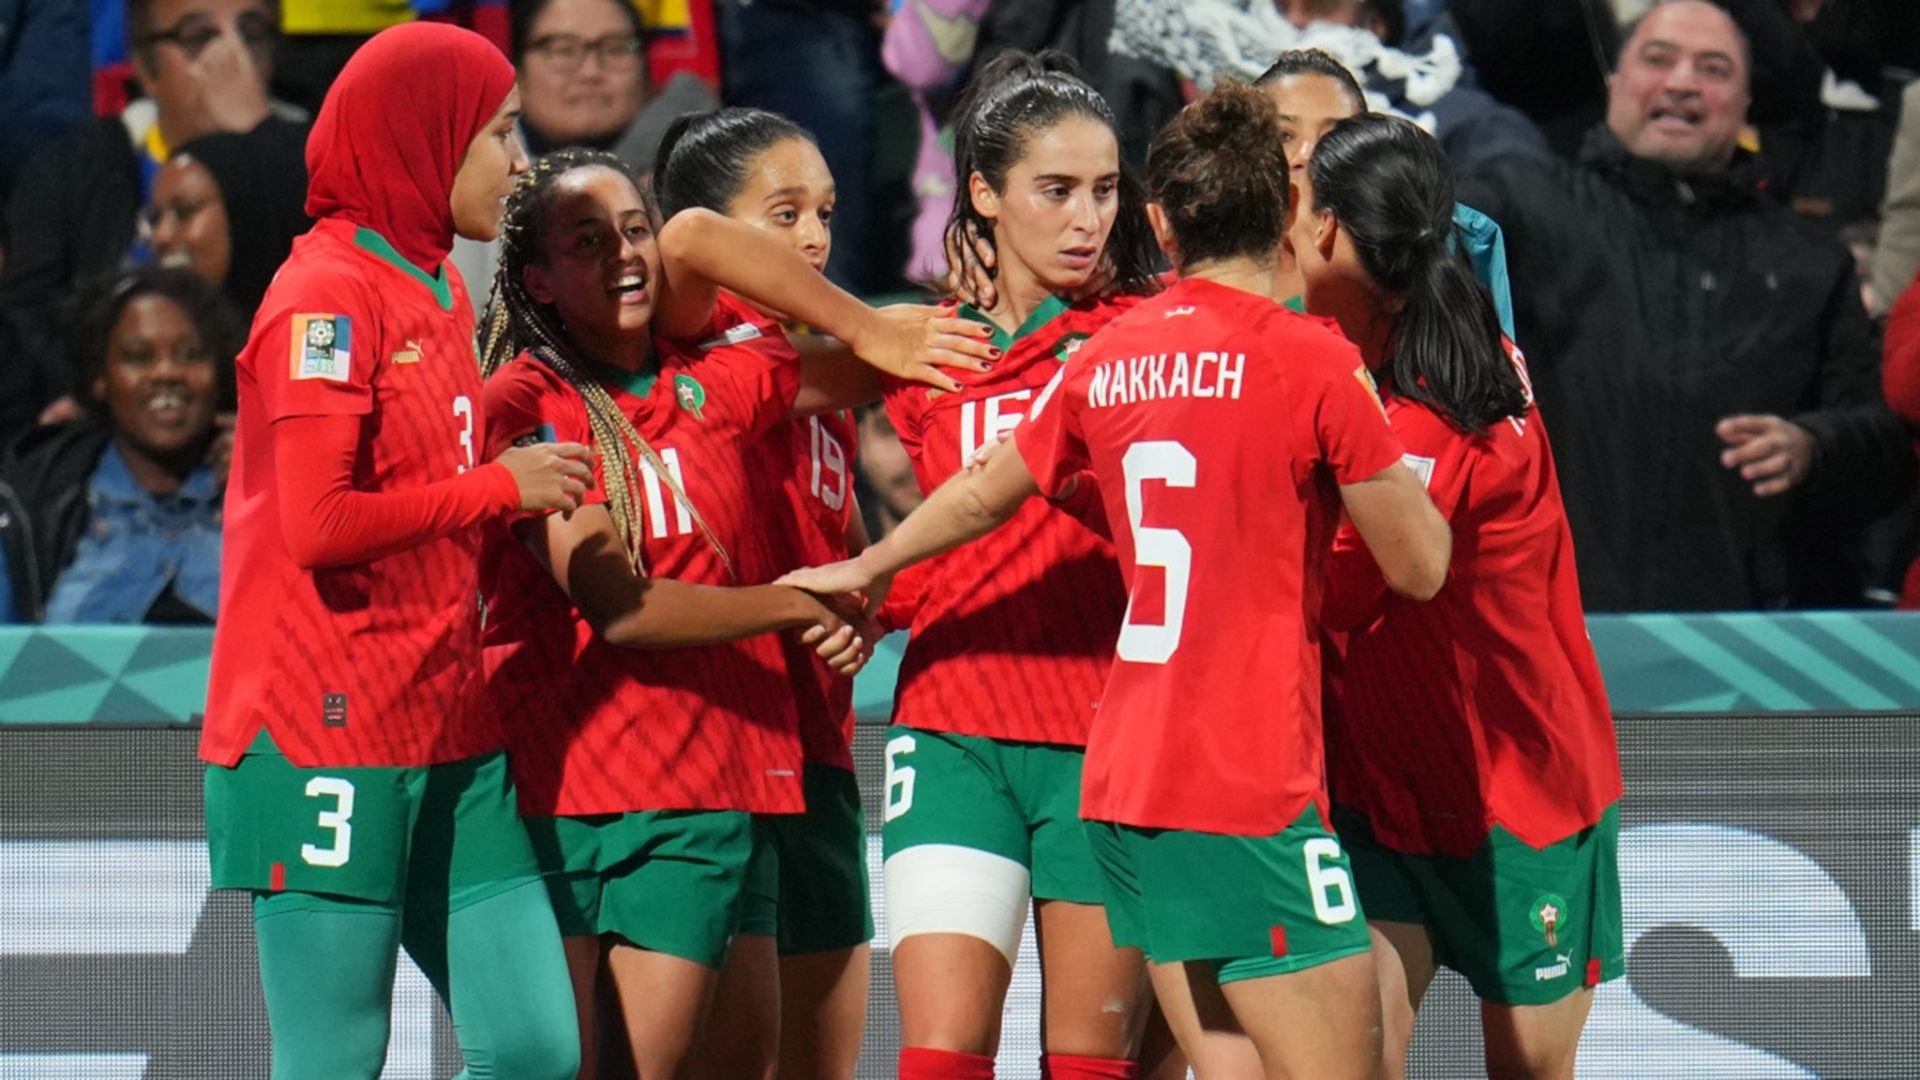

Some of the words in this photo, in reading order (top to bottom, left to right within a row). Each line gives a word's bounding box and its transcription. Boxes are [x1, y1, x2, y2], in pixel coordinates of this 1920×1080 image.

[1088, 352, 1246, 409] NAKKACH
[452, 395, 474, 475] 3
[809, 414, 847, 512] 19
[638, 447, 693, 539] 11
[1115, 440, 1197, 664] 6
[301, 776, 355, 867] 3
[1303, 838, 1357, 925] 6
[1535, 962, 1567, 982] PUMA
